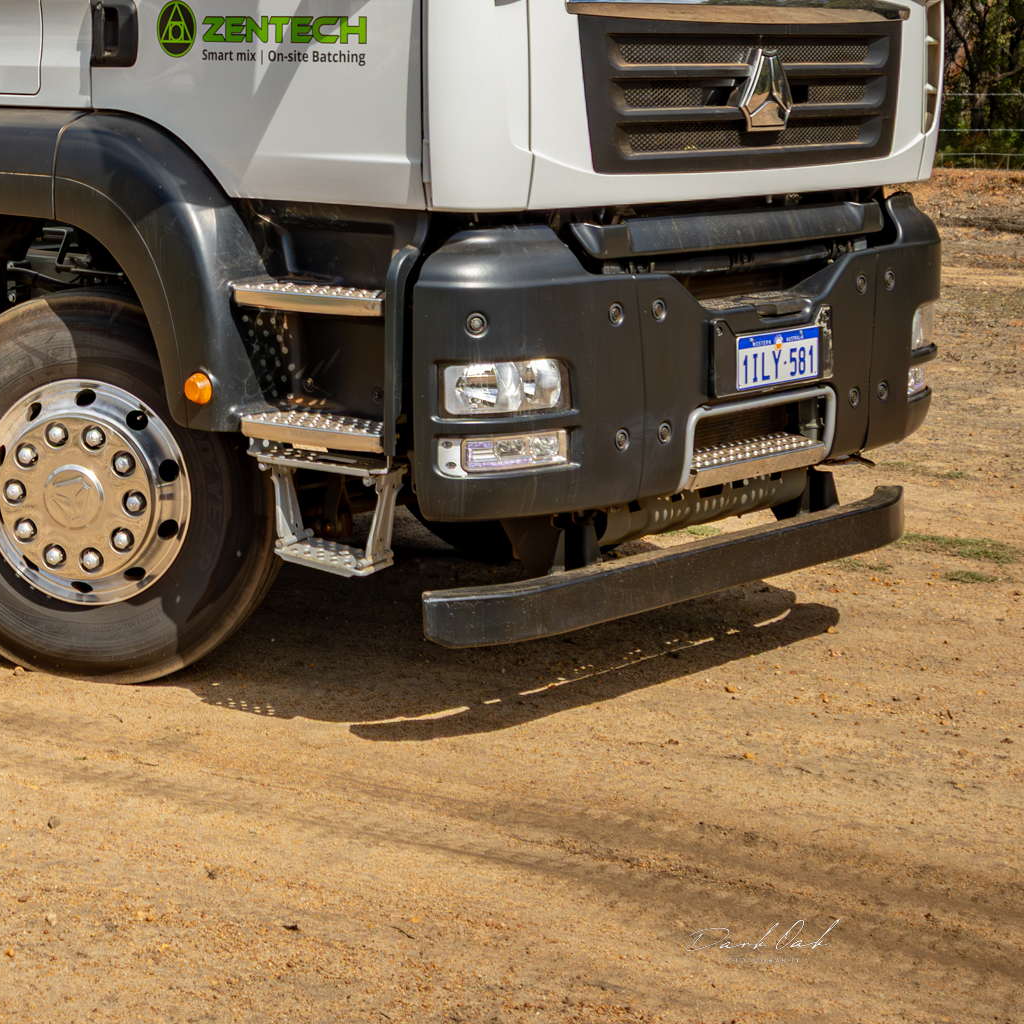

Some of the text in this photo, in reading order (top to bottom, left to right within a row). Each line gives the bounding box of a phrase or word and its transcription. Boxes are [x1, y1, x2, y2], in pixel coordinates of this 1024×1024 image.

[202, 16, 368, 44] ZENTECH
[202, 49, 233, 62] Smart
[236, 49, 257, 62] mix
[268, 49, 309, 63] On-site
[312, 50, 366, 66] Batching
